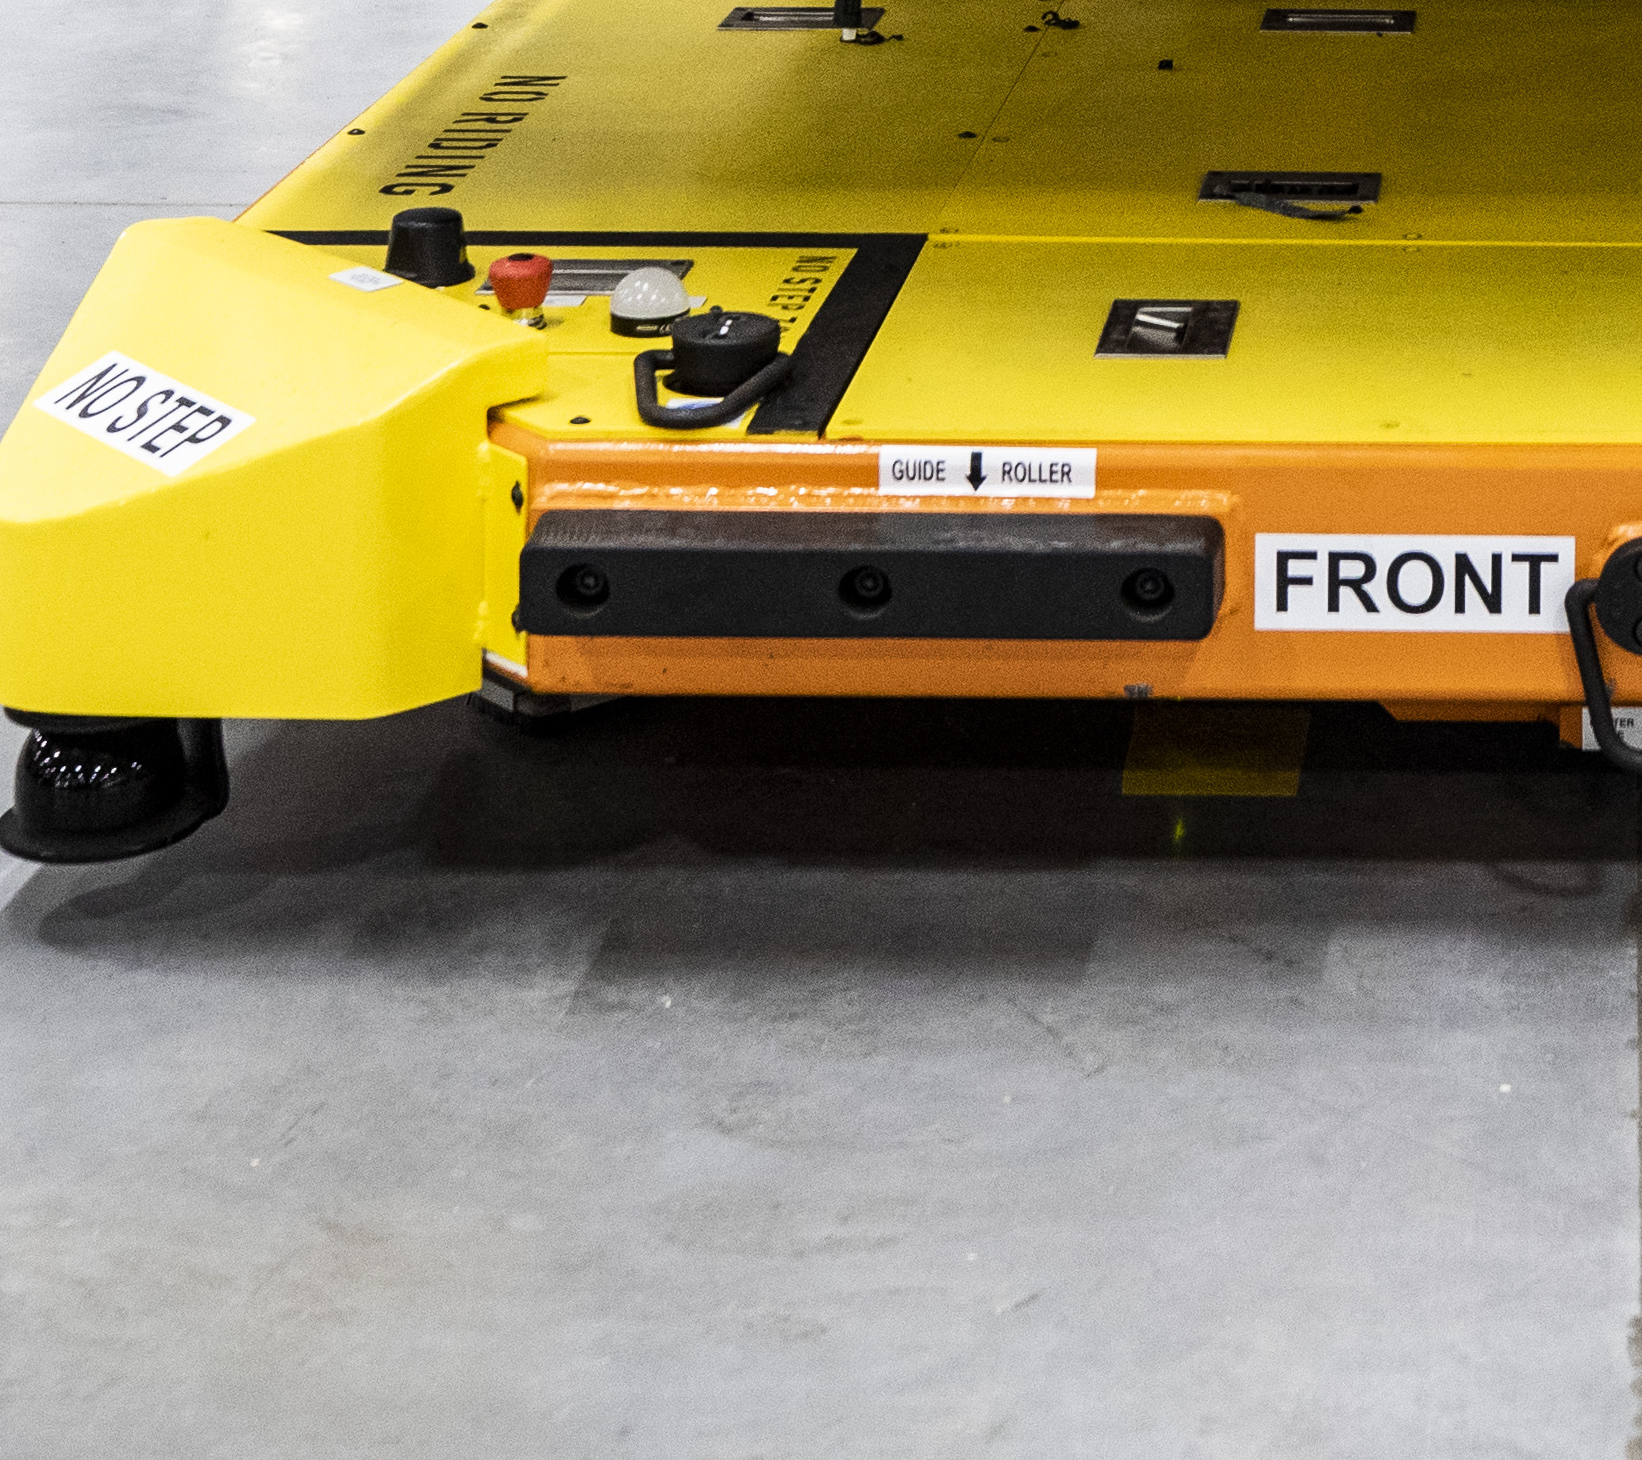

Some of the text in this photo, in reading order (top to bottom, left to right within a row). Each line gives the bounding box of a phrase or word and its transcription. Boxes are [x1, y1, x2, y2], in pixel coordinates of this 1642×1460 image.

[378, 75, 568, 196] NO RIDING
[767, 255, 837, 310] NO STEP
[54, 362, 233, 458] NO STEP
[891, 458, 1073, 486] GUIDE ROLLER
[1276, 551, 1559, 616] FRONT
